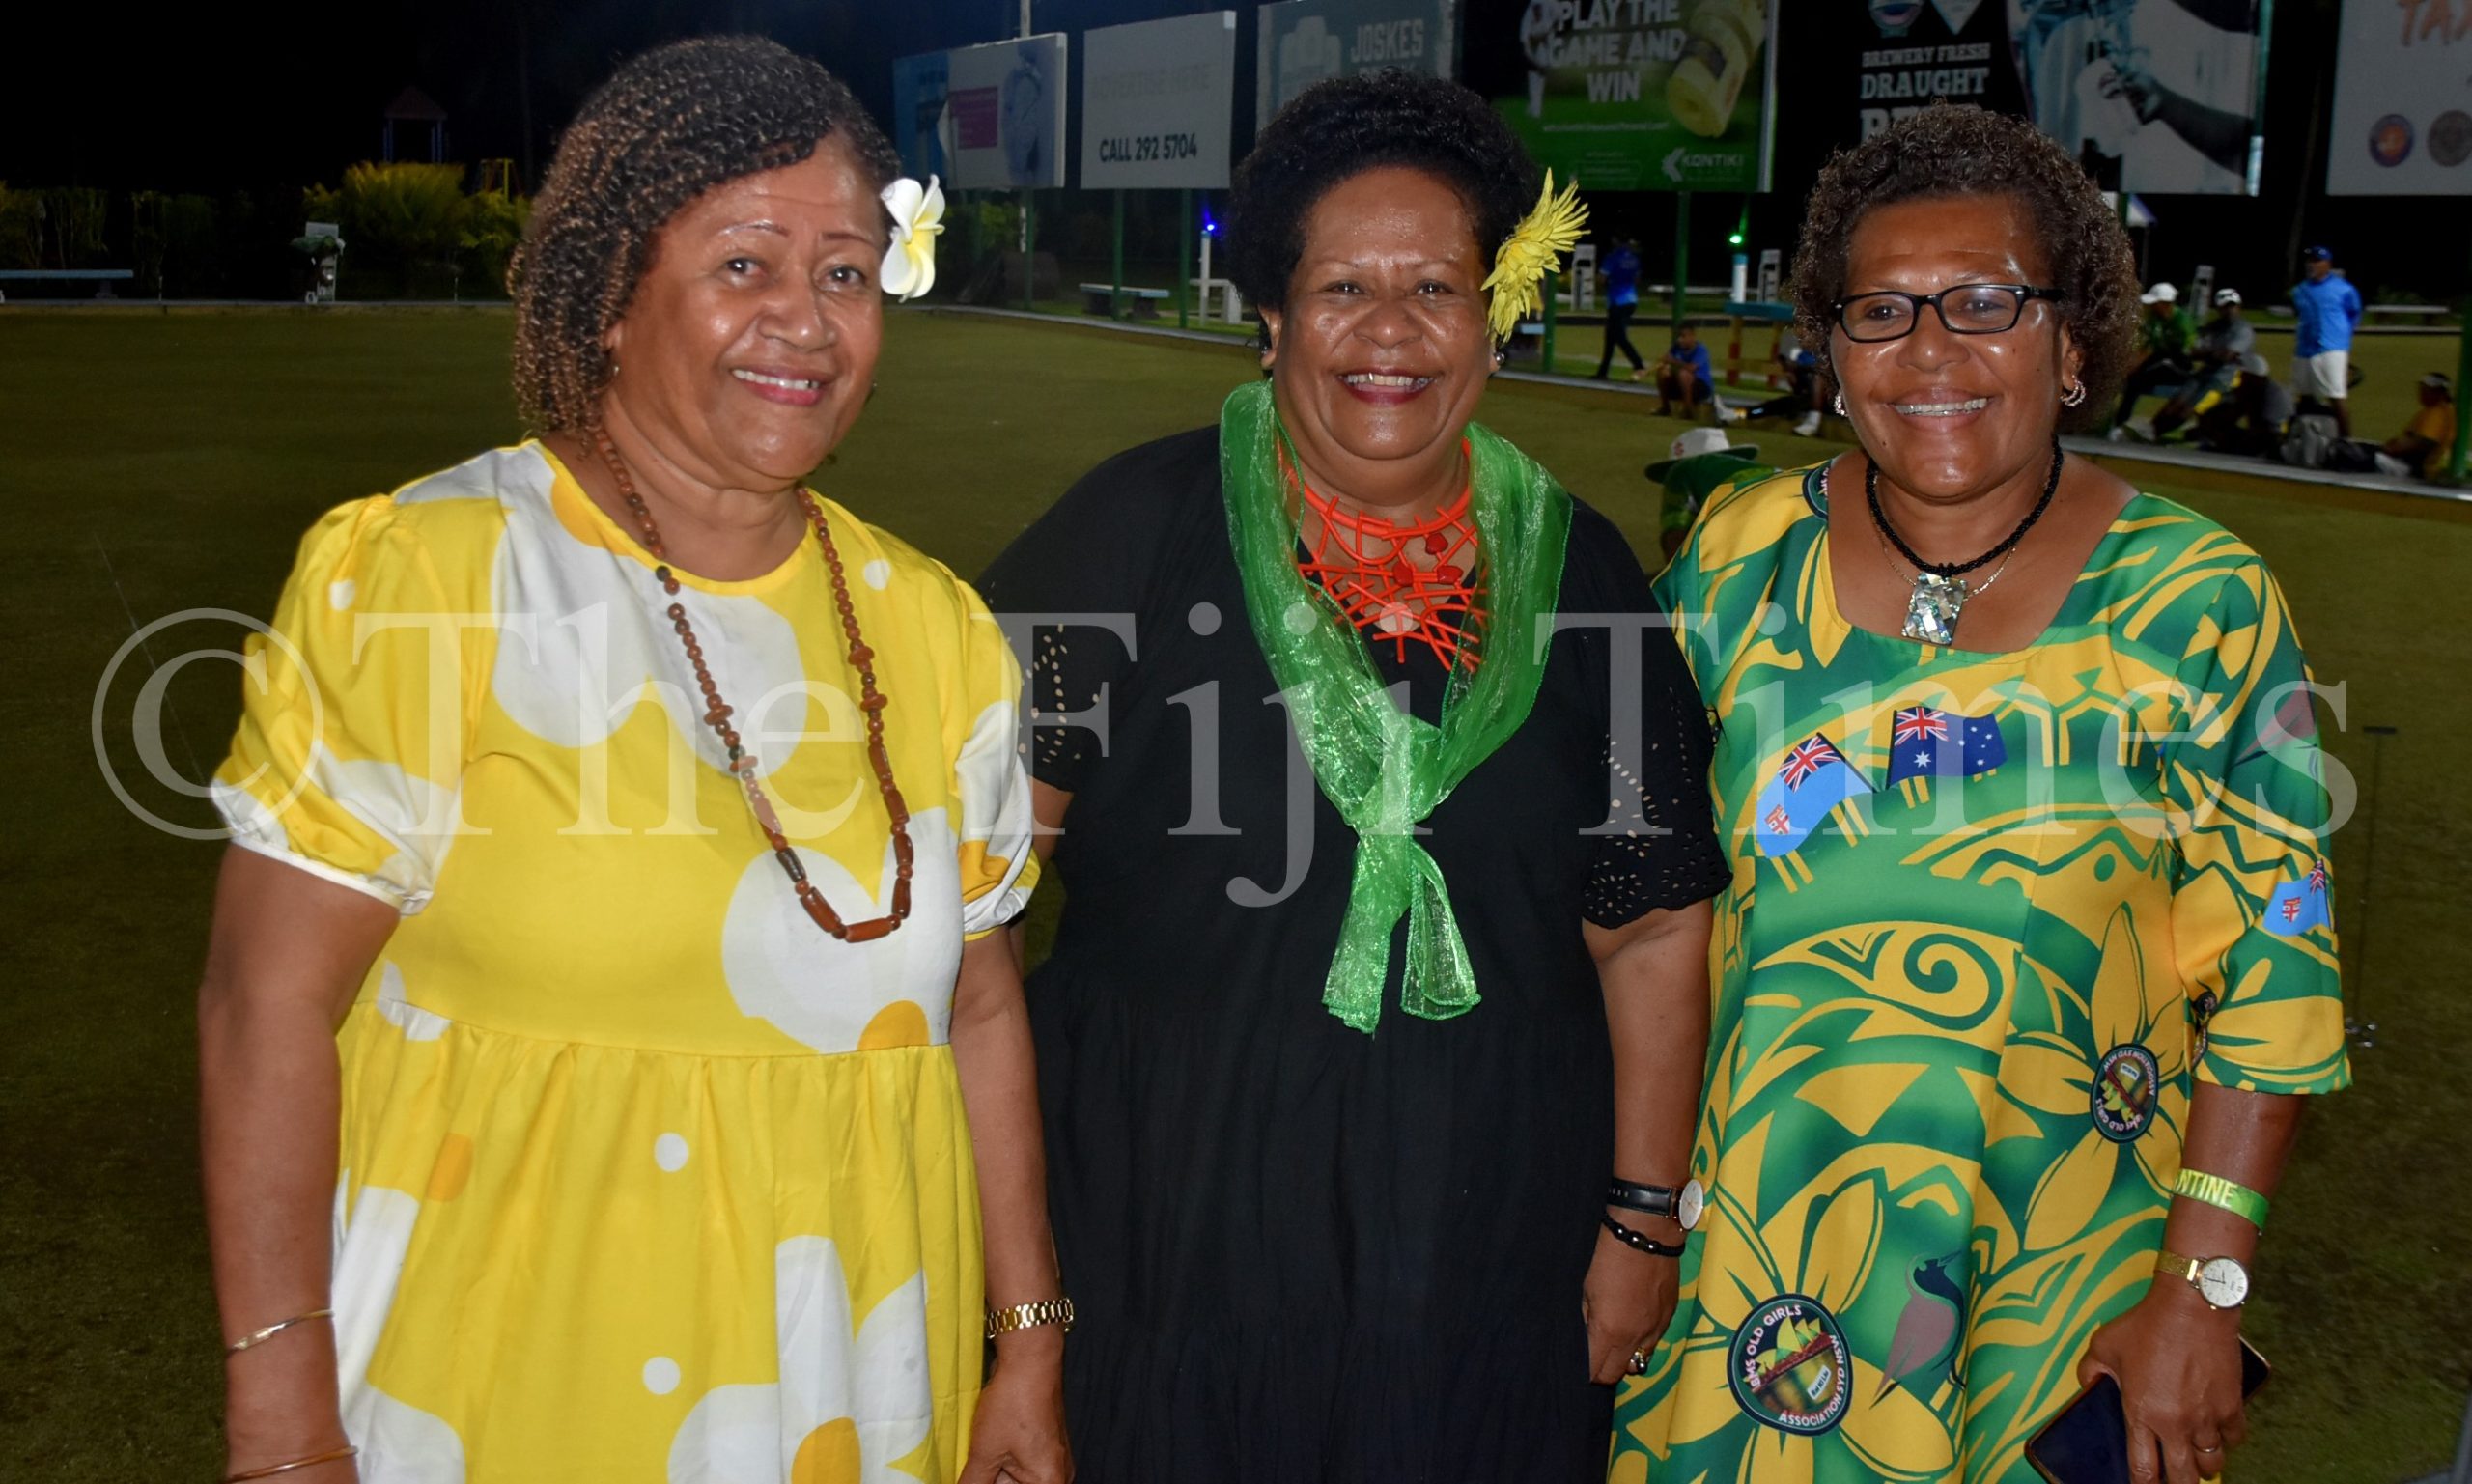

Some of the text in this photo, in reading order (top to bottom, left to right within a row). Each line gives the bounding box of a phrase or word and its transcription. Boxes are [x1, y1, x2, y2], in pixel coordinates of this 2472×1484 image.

[1556, 0, 1681, 31] PLAY THE
[1350, 18, 1424, 63] JOSKES
[1548, 29, 1687, 67] GAME AND
[1861, 42, 1992, 68] BREWERY FRESH
[1587, 70, 1640, 104] WIN
[1860, 67, 1991, 99] DRAUGHT
[1099, 132, 1197, 162] CALL 292 5704
[2175, 1169, 2238, 1208] NTINE
[1746, 1326, 1764, 1356] OLD
[1763, 1304, 1802, 1326] GIRLS
[1778, 1394, 1842, 1426] ASSOCIATION
[1836, 1367, 1845, 1394] SYD
